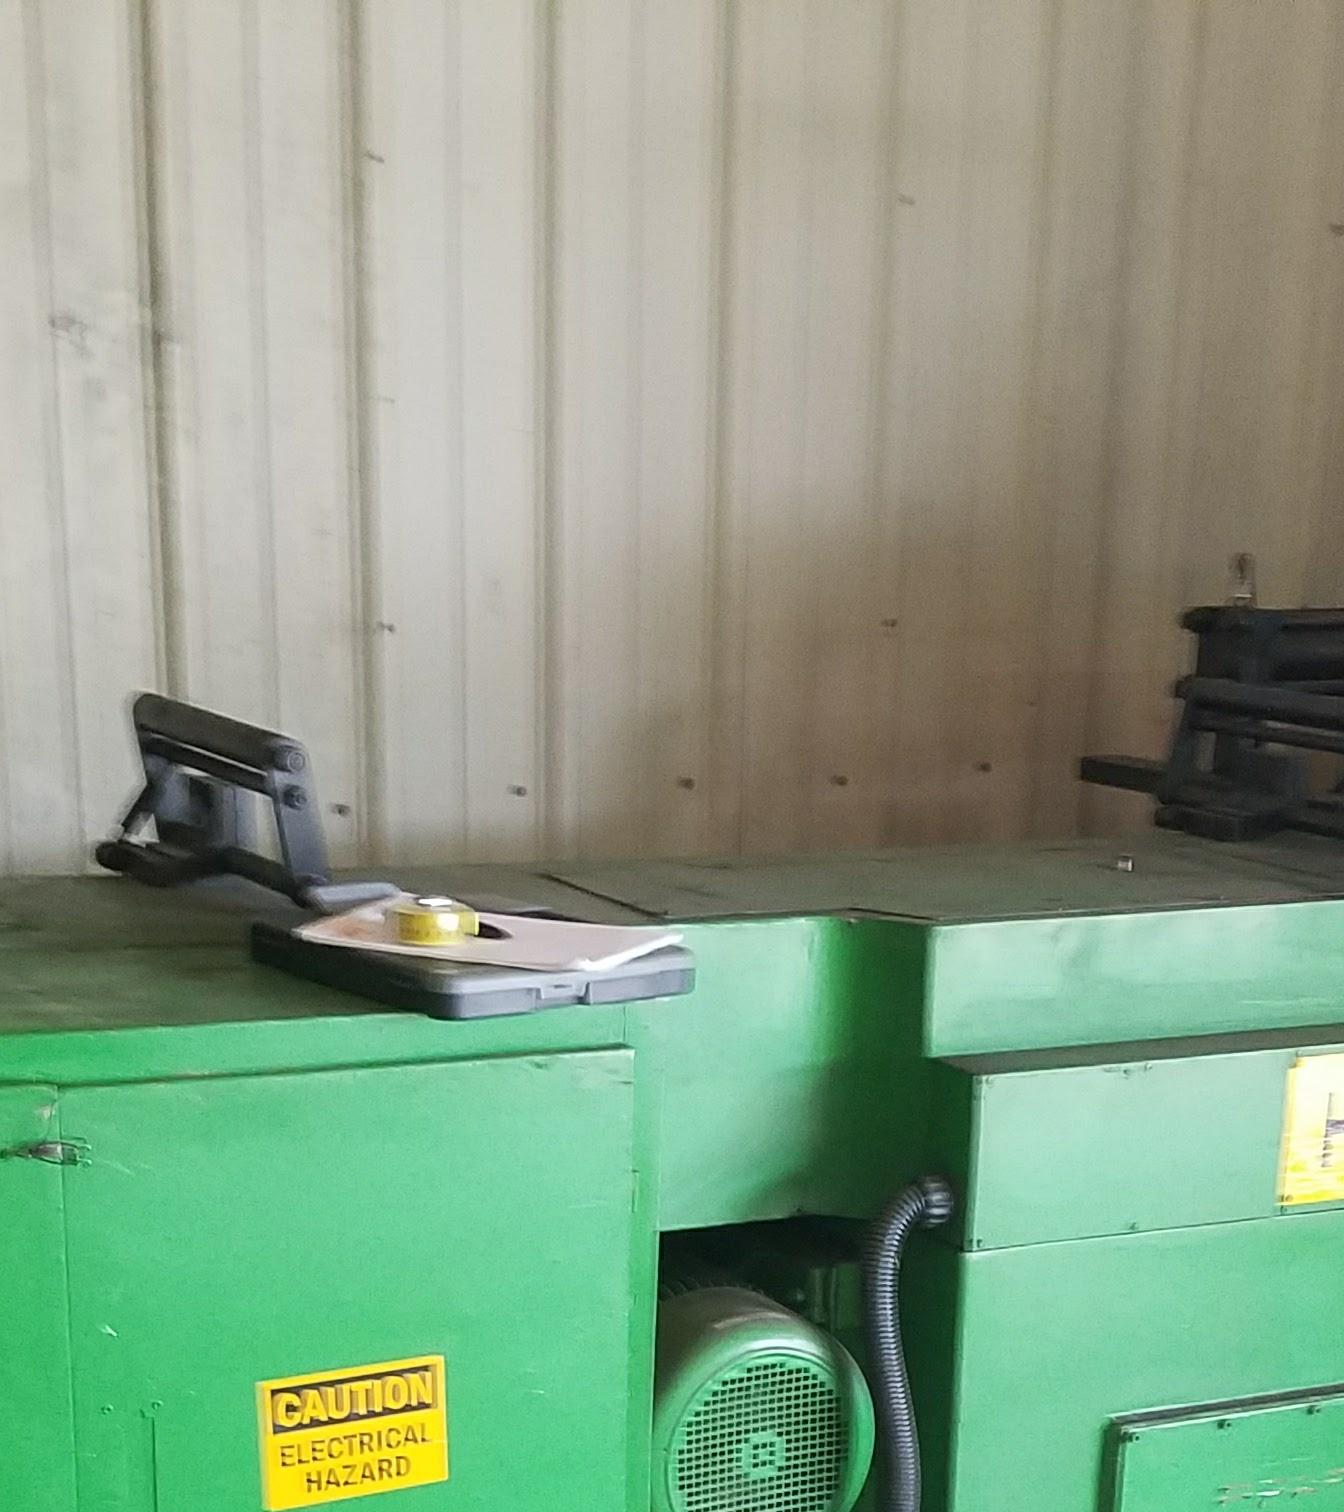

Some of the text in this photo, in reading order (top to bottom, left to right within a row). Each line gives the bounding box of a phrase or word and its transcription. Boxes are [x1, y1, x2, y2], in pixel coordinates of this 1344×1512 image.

[272, 1371, 433, 1428] CAUTION
[280, 1422, 432, 1468] ELECTRICAL
[306, 1456, 412, 1493] HAZARD
